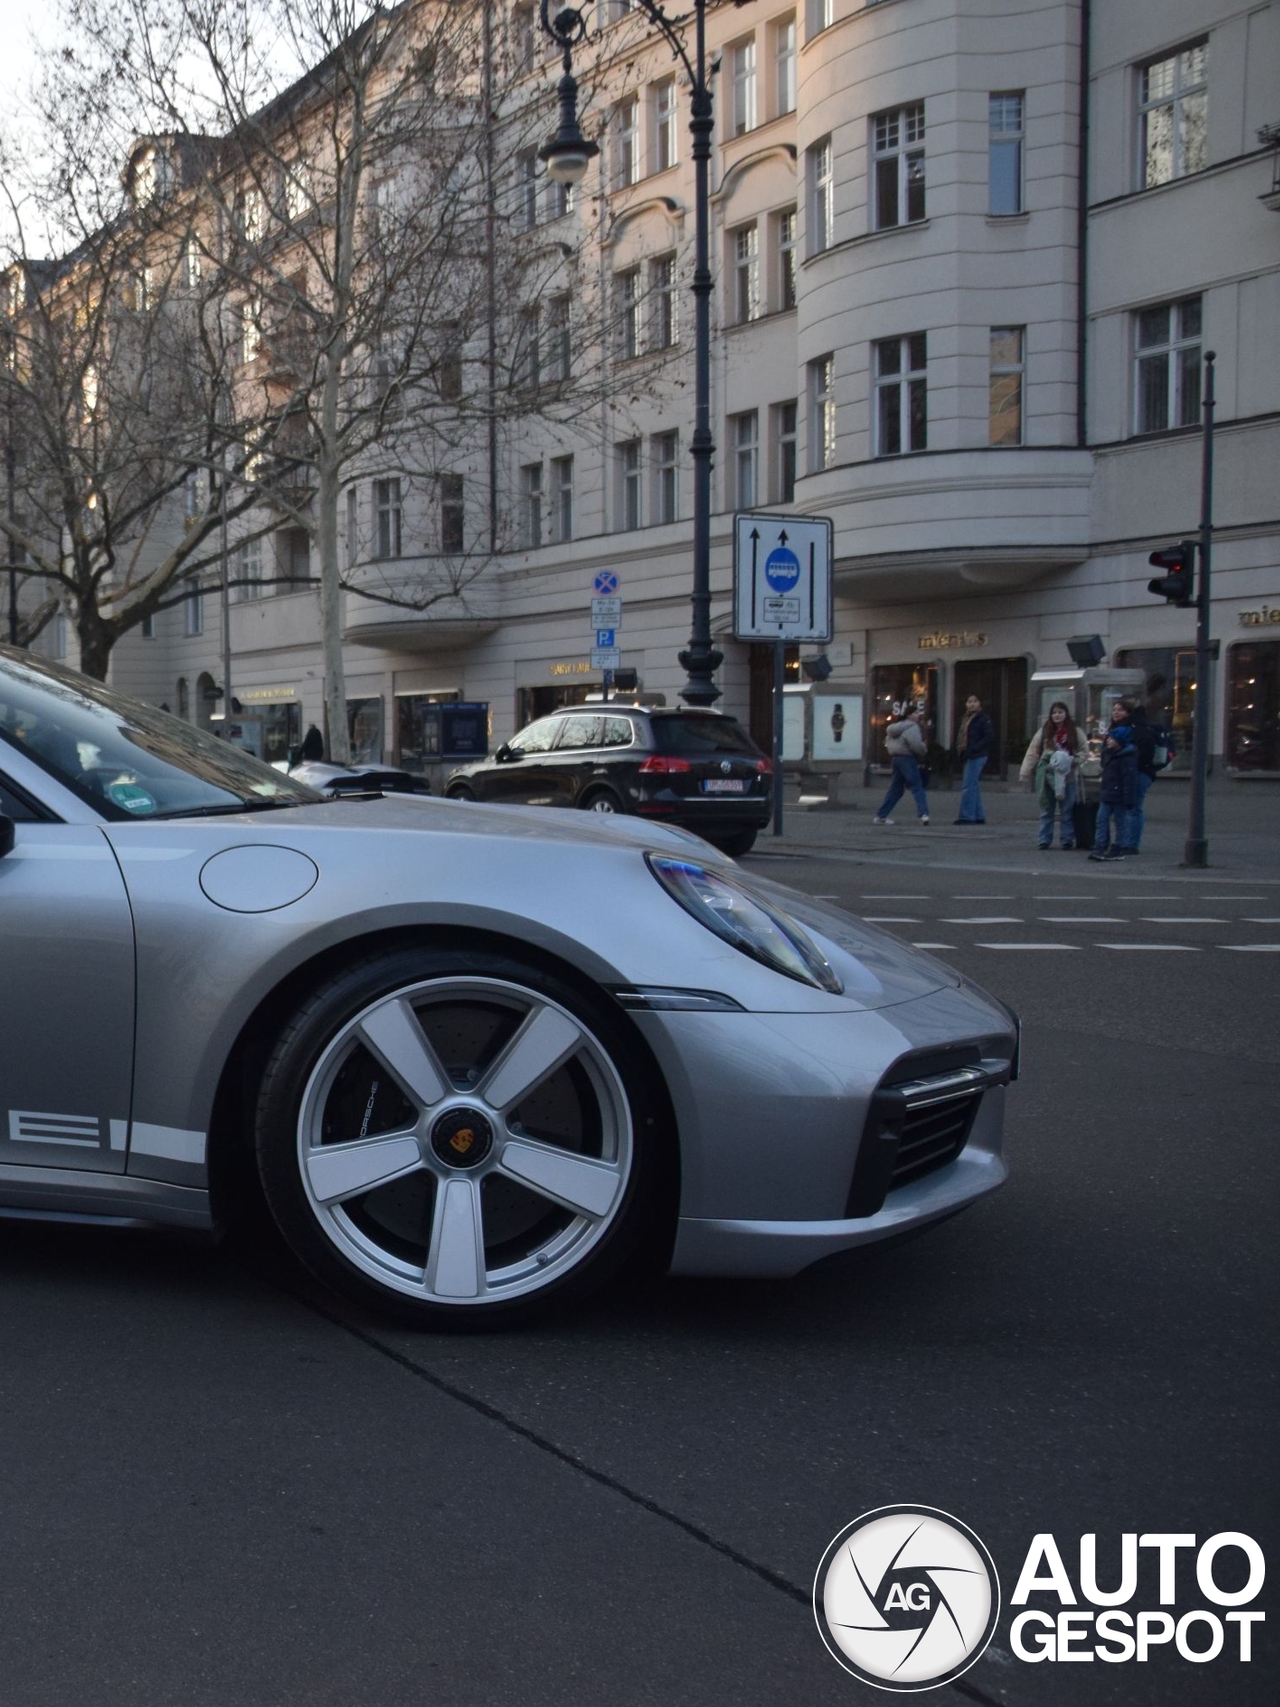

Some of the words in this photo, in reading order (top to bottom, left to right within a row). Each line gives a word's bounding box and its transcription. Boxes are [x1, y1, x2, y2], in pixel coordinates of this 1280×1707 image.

[599, 632, 609, 646] P
[892, 700, 925, 716] SAE
[359, 1080, 379, 1138] ORSCHE
